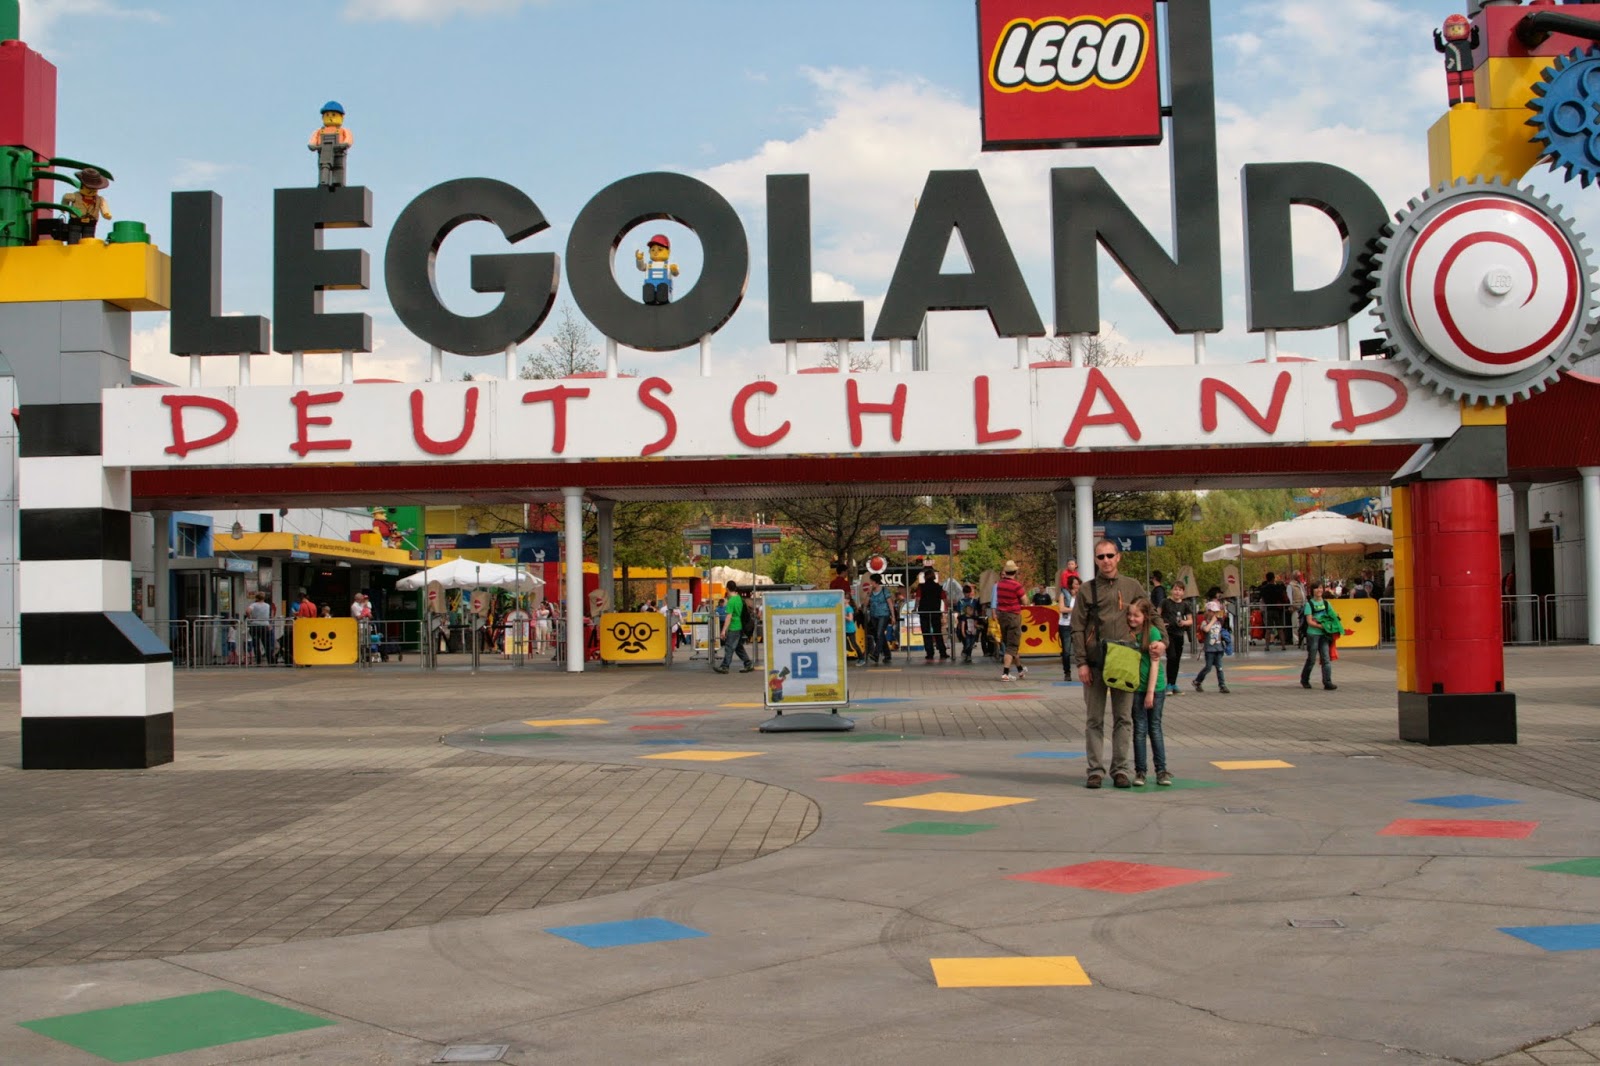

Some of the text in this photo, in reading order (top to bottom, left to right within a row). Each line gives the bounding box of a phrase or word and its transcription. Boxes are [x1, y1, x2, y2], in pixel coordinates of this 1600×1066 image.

[994, 19, 1144, 88] LEGO
[171, 161, 1391, 356] LEGOLAND
[1489, 274, 1512, 288] LEGO
[161, 366, 1408, 457] DEUTSCHLAND
[776, 627, 832, 636] Parkplatzticket
[778, 636, 831, 645] schon gelöst?
[797, 655, 812, 676] P
